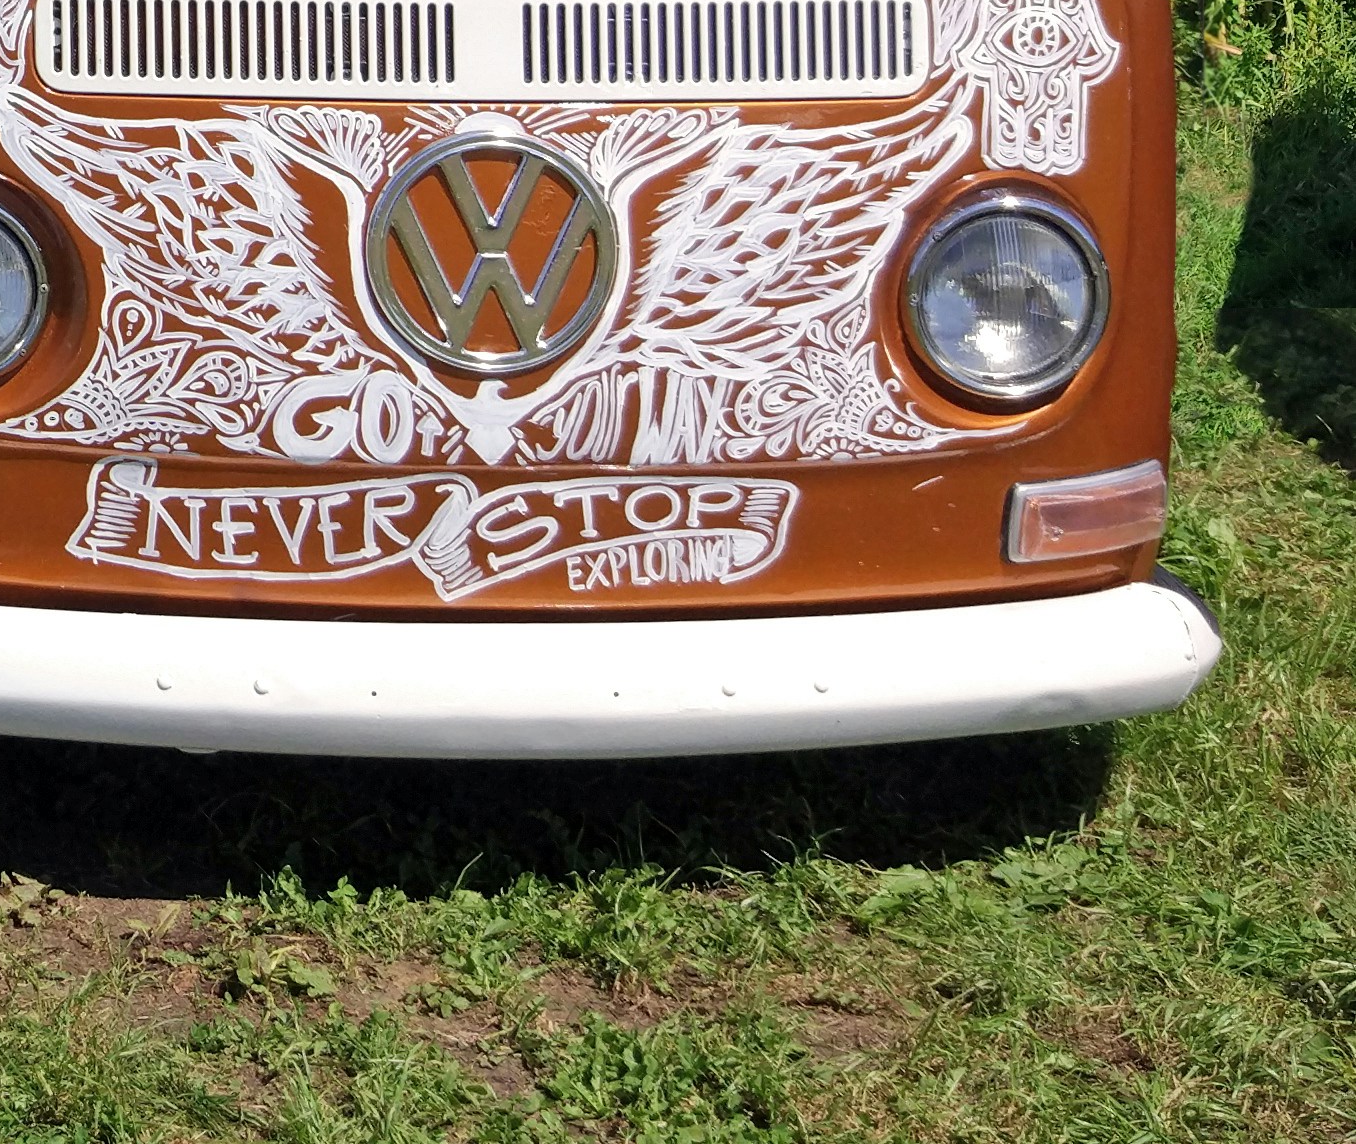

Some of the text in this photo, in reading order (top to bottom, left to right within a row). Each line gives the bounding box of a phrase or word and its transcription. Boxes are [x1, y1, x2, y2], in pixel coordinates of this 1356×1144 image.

[382, 144, 608, 360] VW
[273, 366, 414, 464] GO
[629, 366, 727, 465] WAY
[138, 483, 743, 572] NEVER STOP
[566, 533, 731, 591] EXPLORING
